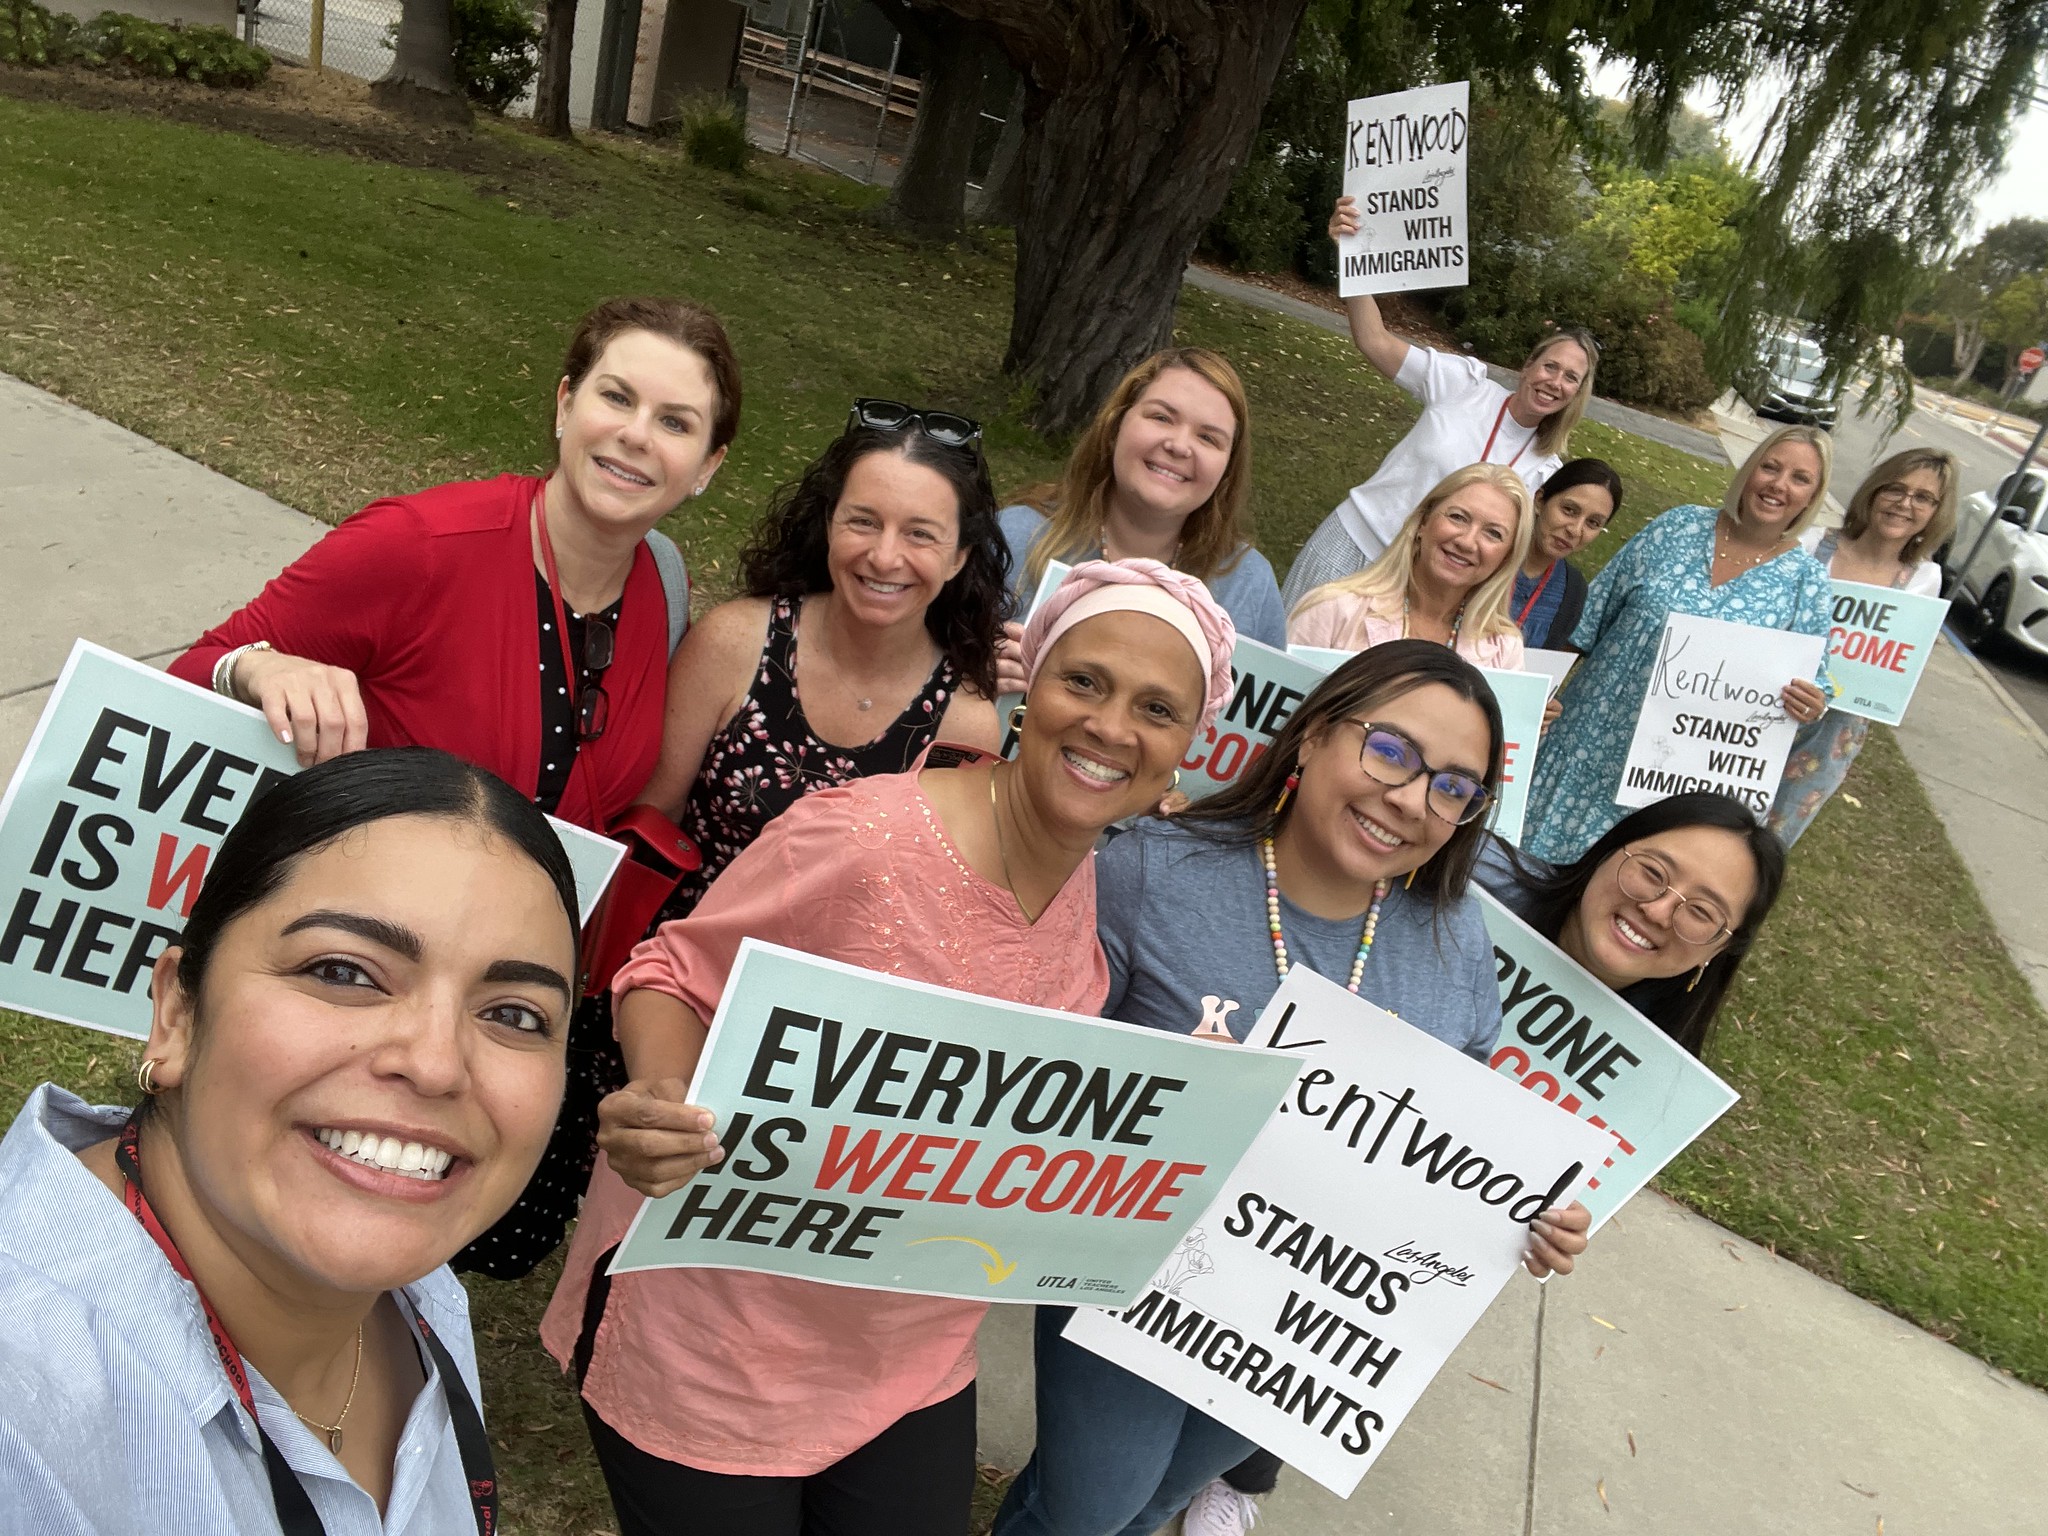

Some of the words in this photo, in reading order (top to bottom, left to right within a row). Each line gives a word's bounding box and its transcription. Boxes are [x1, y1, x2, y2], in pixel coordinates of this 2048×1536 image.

[1347, 107, 1466, 171] KENTWOOD
[1367, 186, 1439, 215] STANDS
[1404, 216, 1452, 241] WITH
[1345, 245, 1464, 278] IMMIGRANTS
[1832, 595, 1898, 633] ONE
[1672, 713, 1761, 748] STANDS
[1708, 749, 1767, 781] WITH
[29, 800, 135, 891] IS
[742, 1006, 1189, 1146] EVERYONE
[702, 1112, 807, 1181] IS
[813, 1125, 1207, 1222] WELCOME
[664, 1184, 905, 1260] HERE
[1223, 1192, 1411, 1316] STANDS
[1036, 1276, 1078, 1289] UTLA
[1274, 1290, 1402, 1389] WITH
[1097, 1289, 1384, 1456] MMIGRANTS
